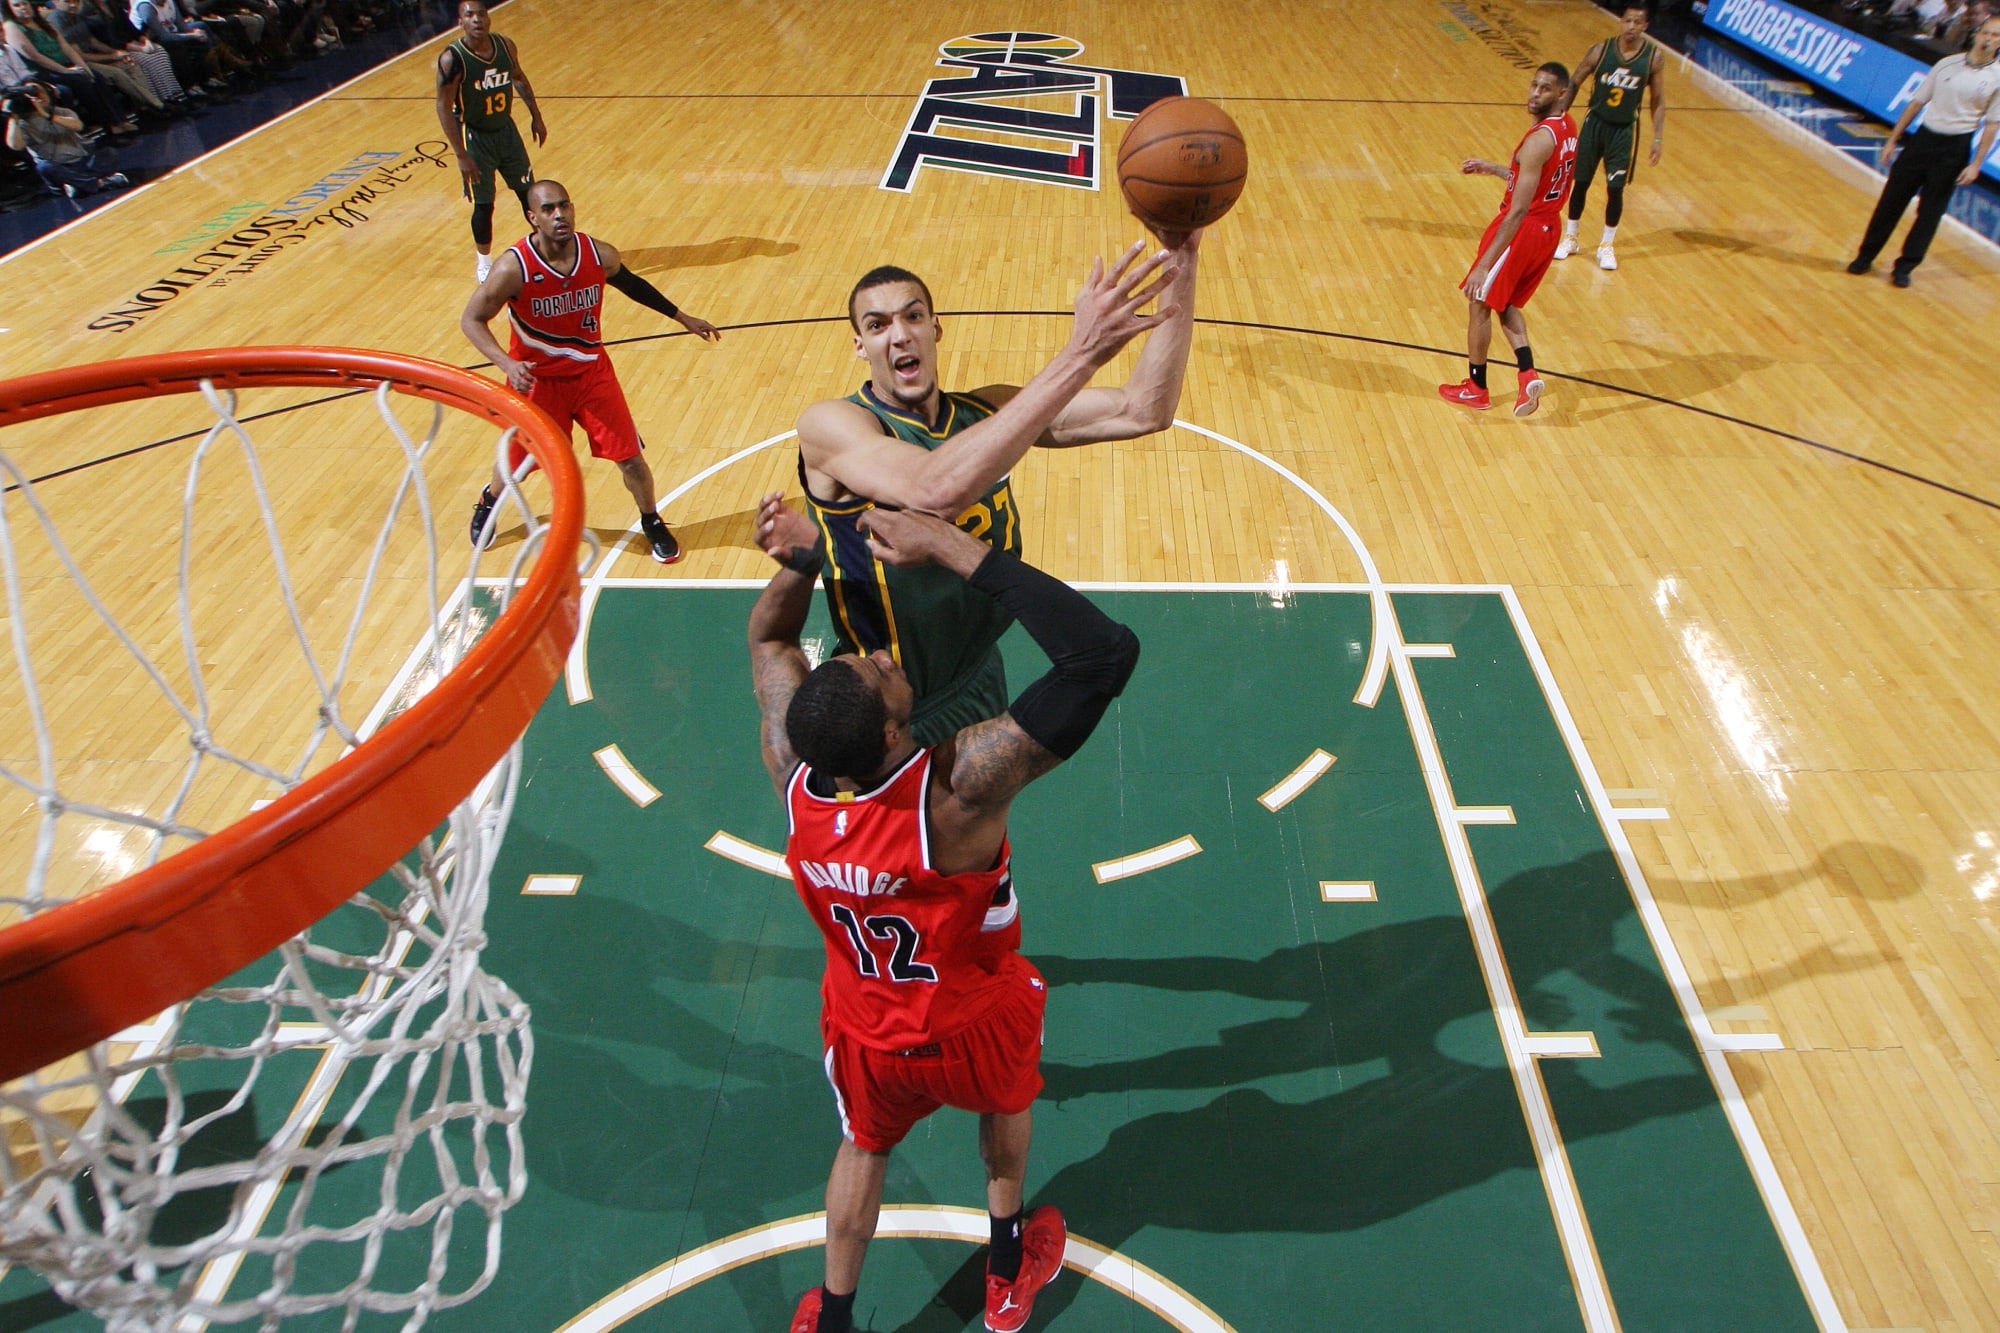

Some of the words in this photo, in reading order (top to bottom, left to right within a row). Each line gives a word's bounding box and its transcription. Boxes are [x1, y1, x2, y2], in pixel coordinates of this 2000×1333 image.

[1715, 0, 1862, 83] PROGRESSIVE
[474, 67, 512, 91] JAZZ
[1601, 67, 1641, 89] JAZZ
[485, 92, 507, 115] 13
[1607, 88, 1623, 106] 3
[152, 199, 268, 256] ARENA
[225, 234, 307, 275] Court
[531, 283, 600, 318] PORTLAND
[581, 310, 598, 333] 4
[955, 486, 1015, 551] 27
[830, 902, 939, 983] 12
